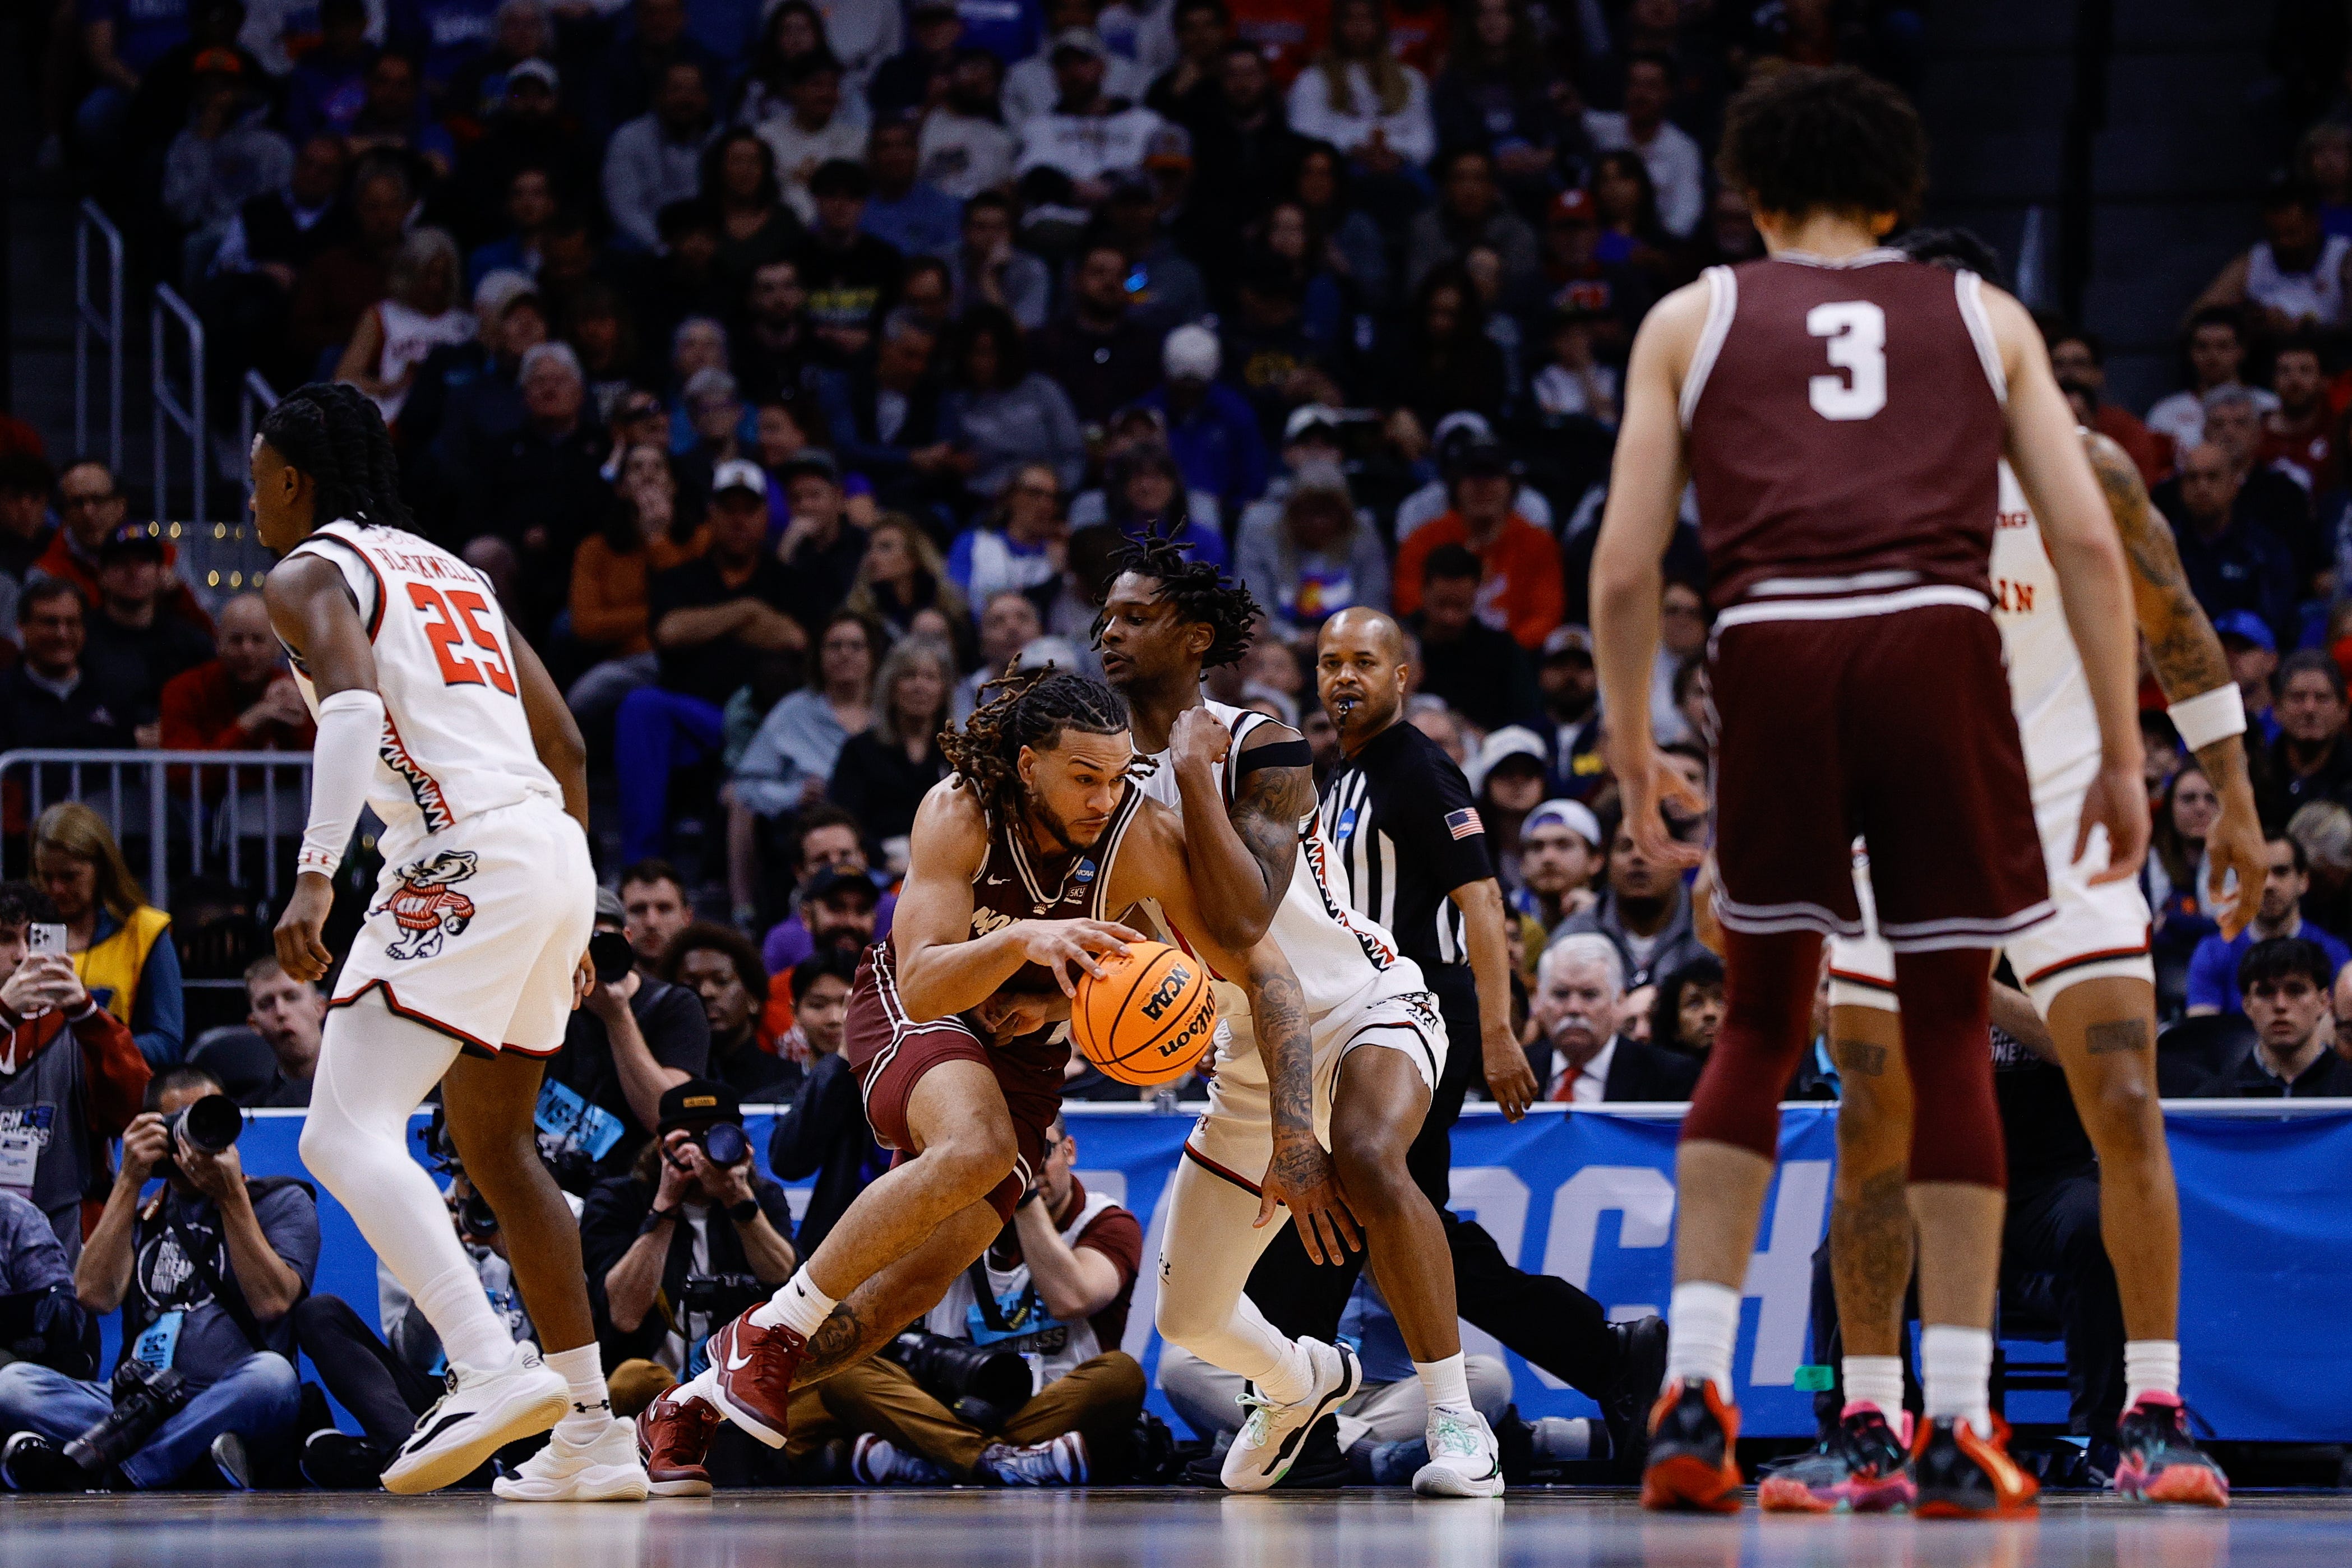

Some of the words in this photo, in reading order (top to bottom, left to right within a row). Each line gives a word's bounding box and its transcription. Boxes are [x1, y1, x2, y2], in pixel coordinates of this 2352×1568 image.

[1806, 300, 1888, 421] 3
[405, 582, 517, 699] 25
[1141, 963, 1192, 1021] NCAA
